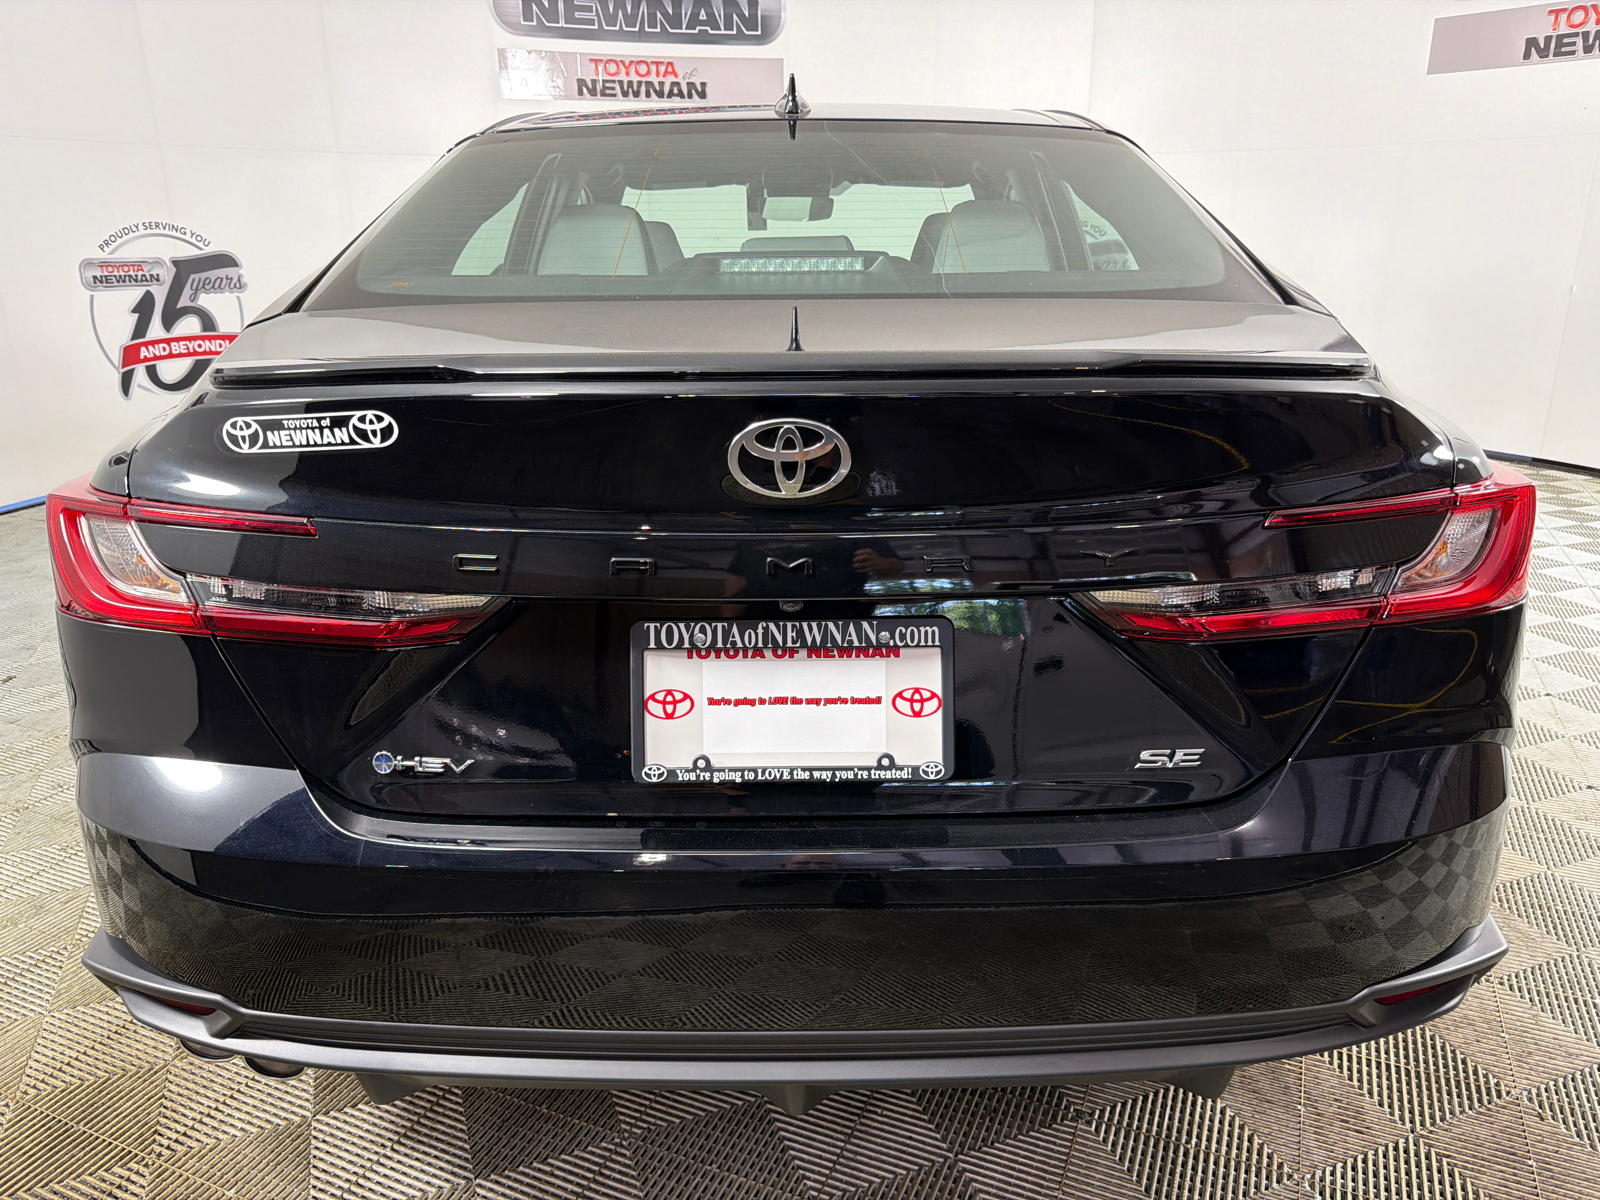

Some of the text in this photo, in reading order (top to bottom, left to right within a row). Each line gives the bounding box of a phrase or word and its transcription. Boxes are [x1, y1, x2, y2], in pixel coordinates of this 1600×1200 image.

[520, 0, 762, 34] NEWNAN
[588, 58, 698, 80] TOYOTA of
[576, 78, 708, 100] NEWNAN
[98, 221, 211, 253] PROUDLY SERVING YOU
[97, 263, 146, 274] TOYOTA
[91, 273, 160, 285] NEWNAN
[120, 253, 246, 398] 15 years
[140, 343, 170, 359] AND
[282, 417, 331, 429] TOYOTA of
[266, 427, 350, 447] NEWNAN
[452, 547, 1139, 576] CAMRY
[707, 696, 882, 708] You're going to LOVE the way you're treated!
[1133, 748, 1206, 769] SE
[713, 769, 742, 783] going
[744, 769, 755, 780] to
[757, 768, 791, 780] LOVE
[793, 768, 810, 780] the
[812, 770, 833, 782] way
[871, 768, 912, 780] treated!
